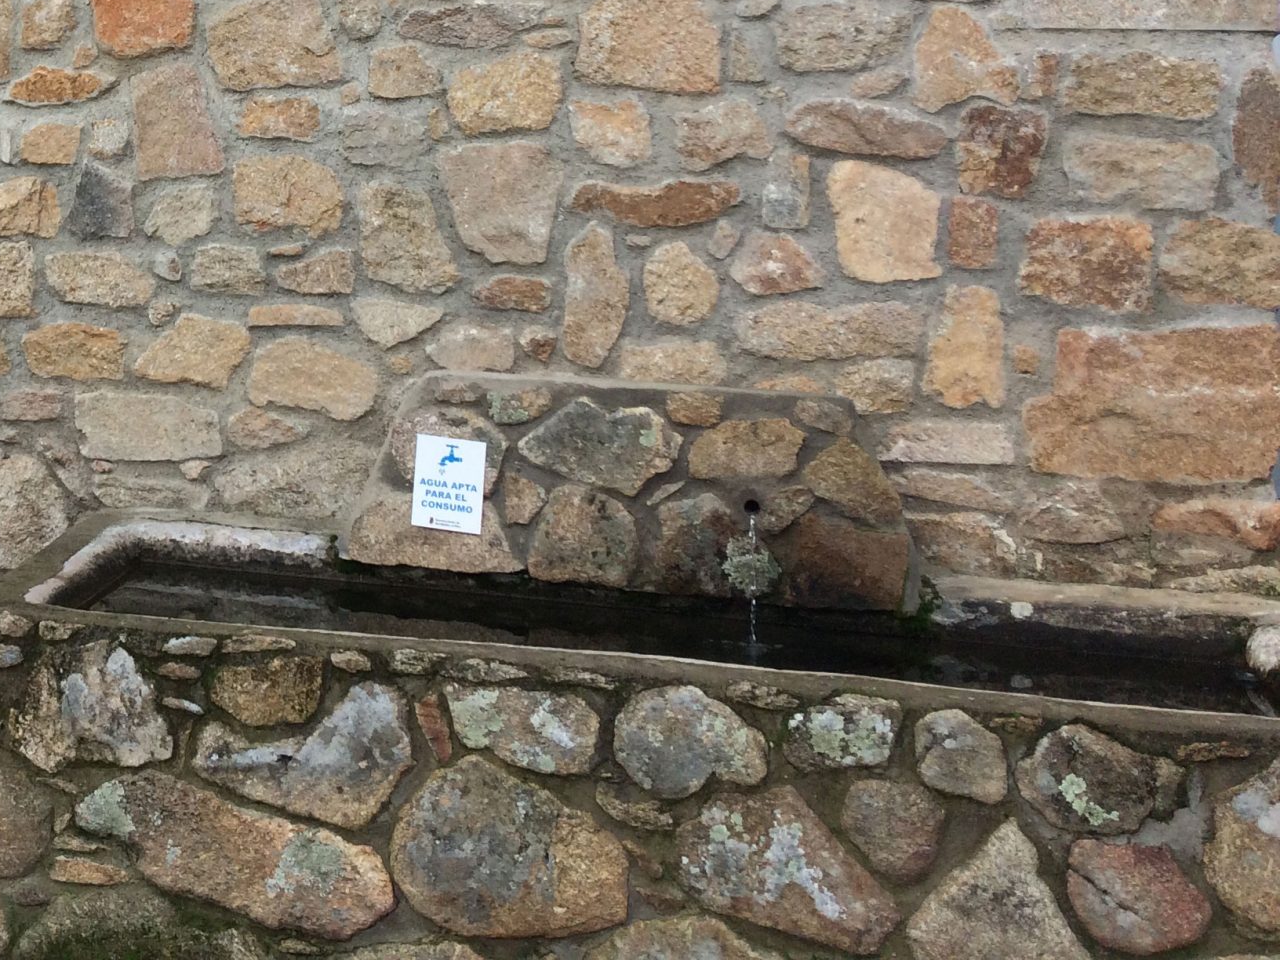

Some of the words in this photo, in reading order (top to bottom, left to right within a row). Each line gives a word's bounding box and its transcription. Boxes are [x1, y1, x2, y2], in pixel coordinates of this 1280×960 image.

[420, 478, 448, 488] AGUA
[451, 482, 477, 492] APTA
[425, 489, 452, 500] PARA
[455, 493, 467, 502] EL
[421, 500, 473, 514] CONSUMO
